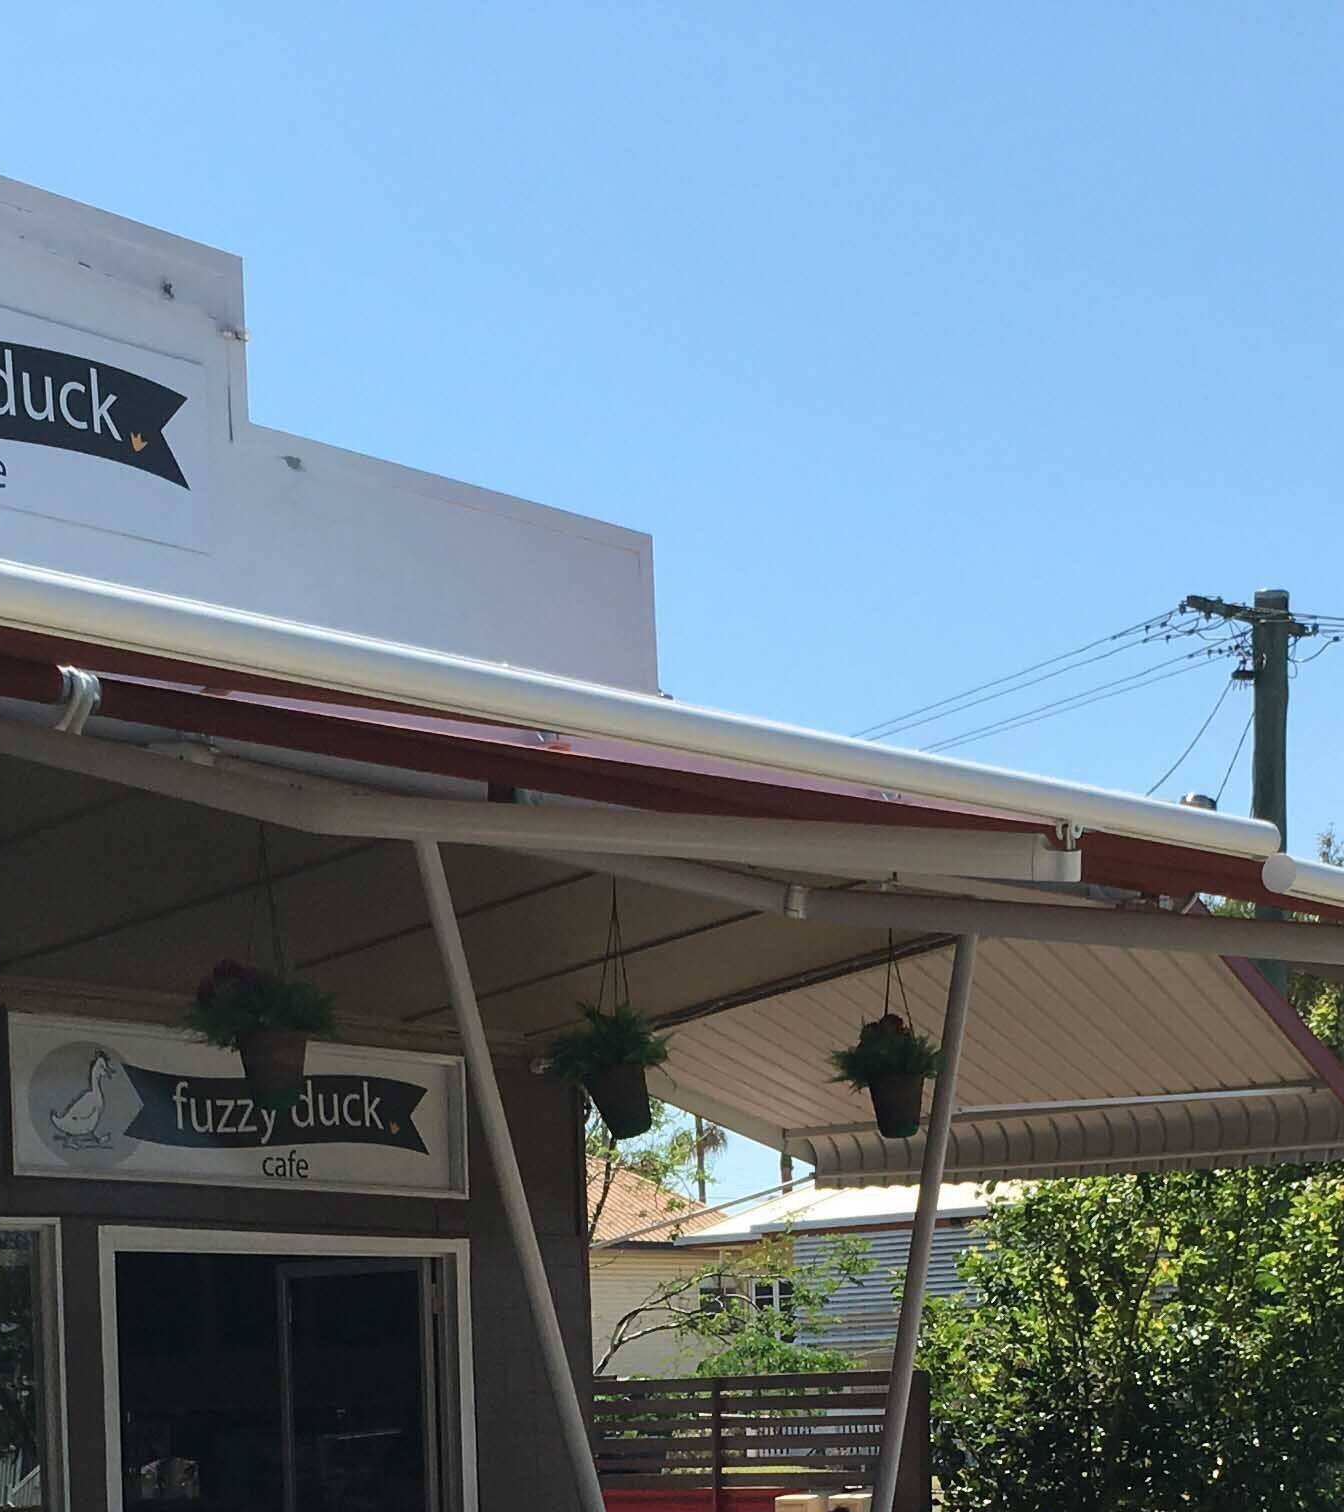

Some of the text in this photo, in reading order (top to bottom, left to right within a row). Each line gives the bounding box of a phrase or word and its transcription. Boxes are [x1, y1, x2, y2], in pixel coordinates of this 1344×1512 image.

[172, 1079, 384, 1145] fuzzy duck
[262, 1150, 309, 1178] cafe
